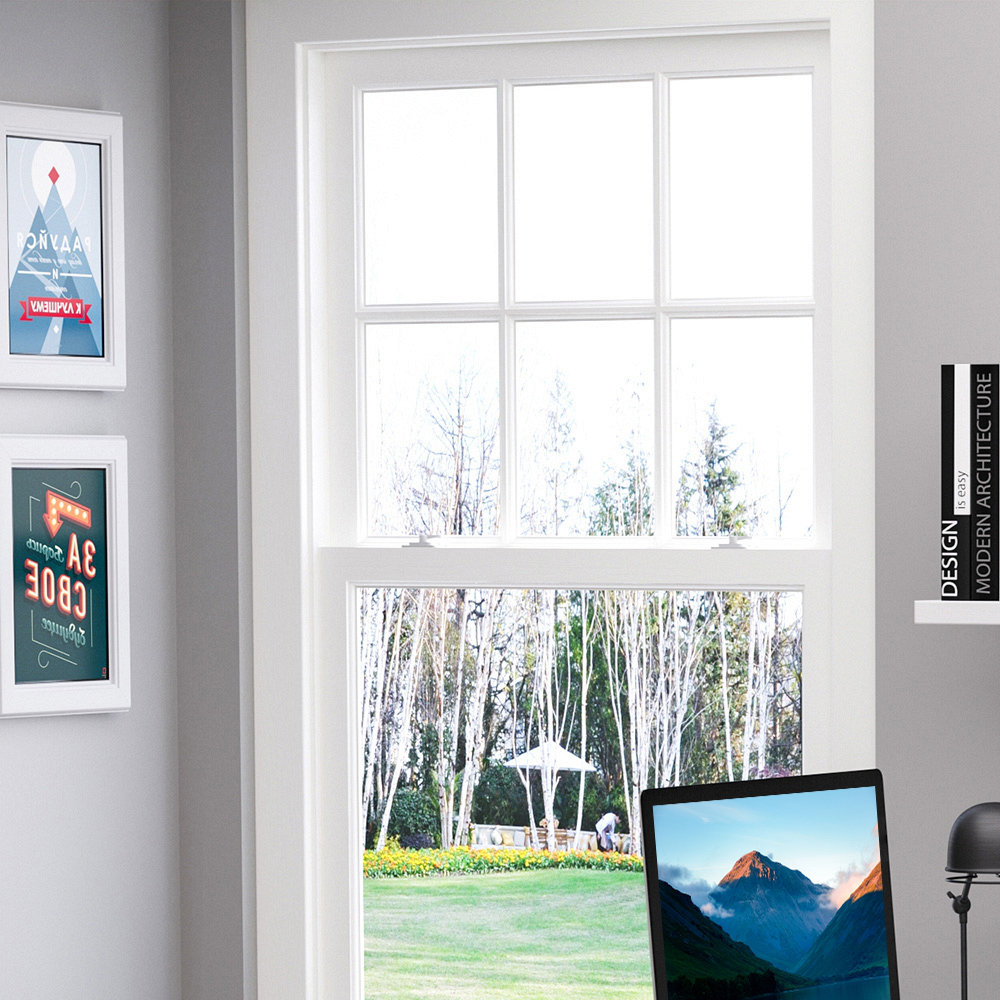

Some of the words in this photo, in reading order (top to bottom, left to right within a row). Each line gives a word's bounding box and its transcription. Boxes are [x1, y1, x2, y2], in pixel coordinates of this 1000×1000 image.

[976, 373, 992, 509] ARCHITECTURE
[957, 470, 969, 498] easy
[957, 499, 966, 509] is
[941, 520, 958, 598] DESIGN
[976, 514, 991, 594] MODERN
